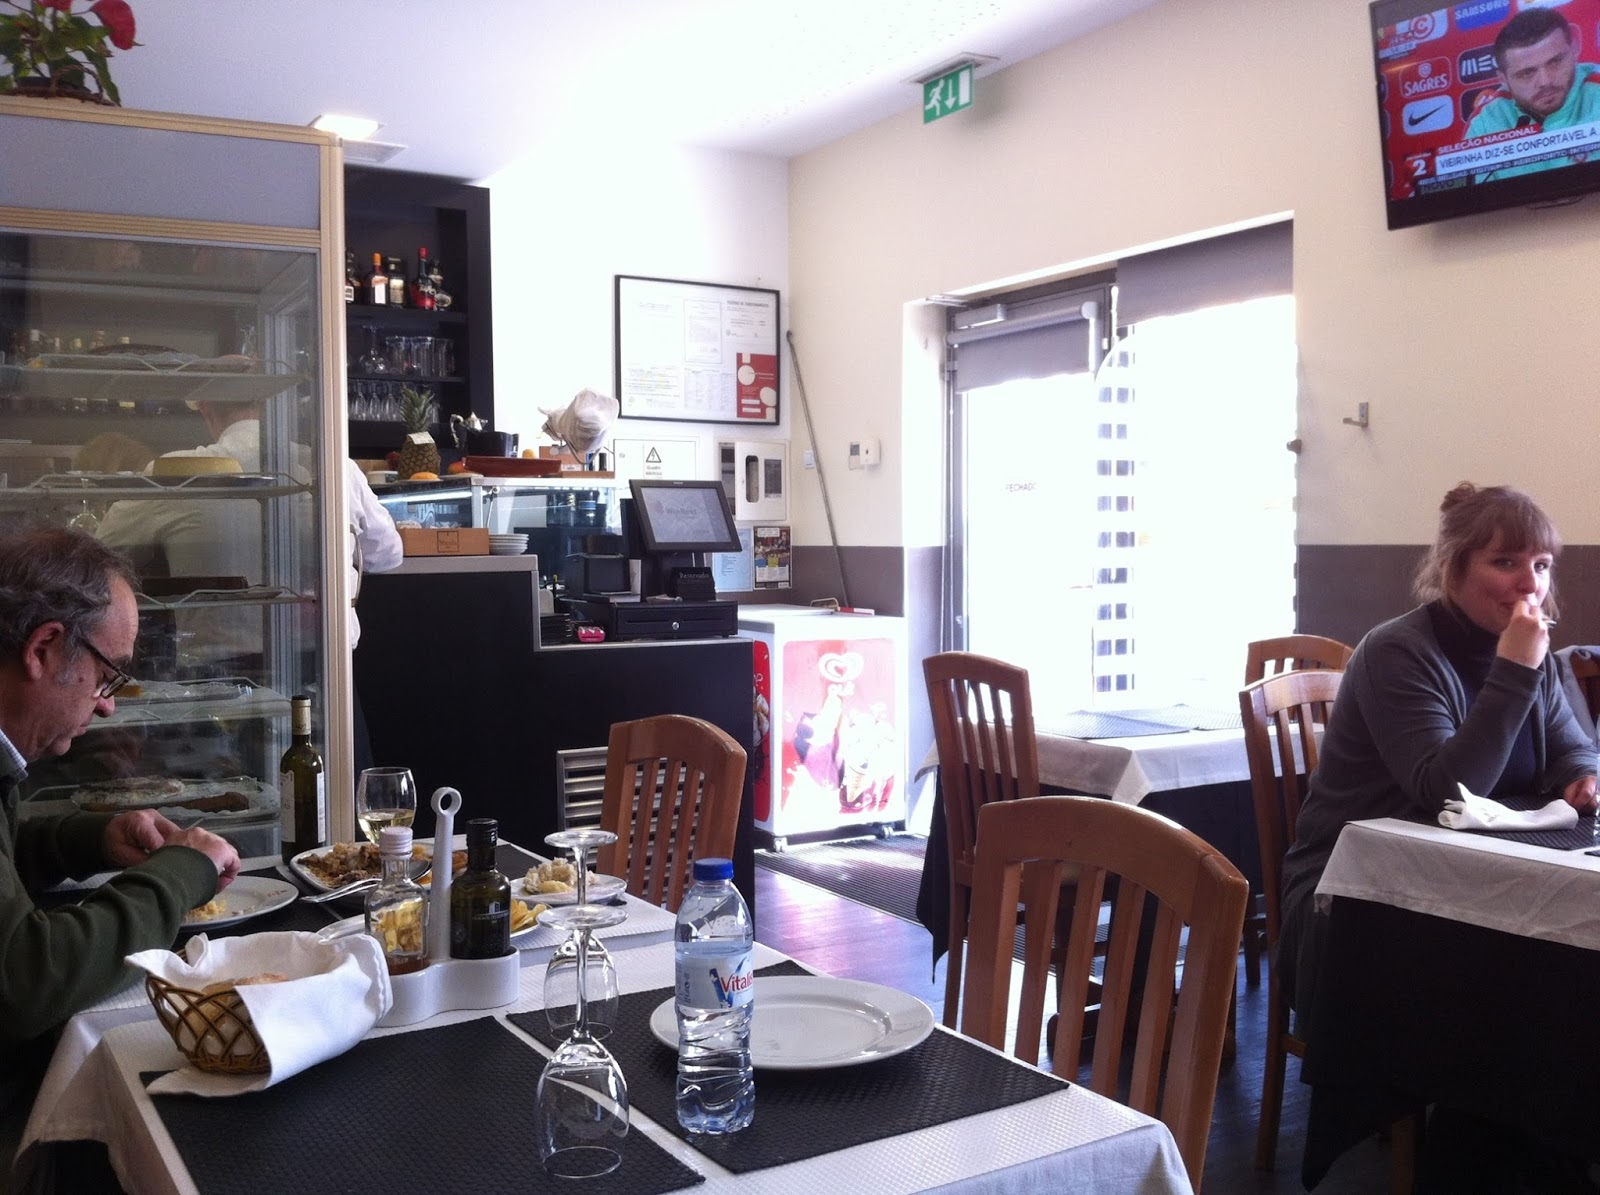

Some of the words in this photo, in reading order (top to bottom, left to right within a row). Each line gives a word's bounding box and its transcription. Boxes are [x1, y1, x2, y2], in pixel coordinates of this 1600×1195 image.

[1404, 73, 1448, 97] SAGRES
[1438, 138, 1482, 154] SELEÇÃO
[1484, 126, 1538, 145] NACIONAL
[1439, 152, 1484, 169] VIEIRINHA
[1485, 144, 1515, 160] DIZ-SE
[1516, 129, 1587, 152] CONFORTÁVEL
[1412, 159, 1427, 176] 2
